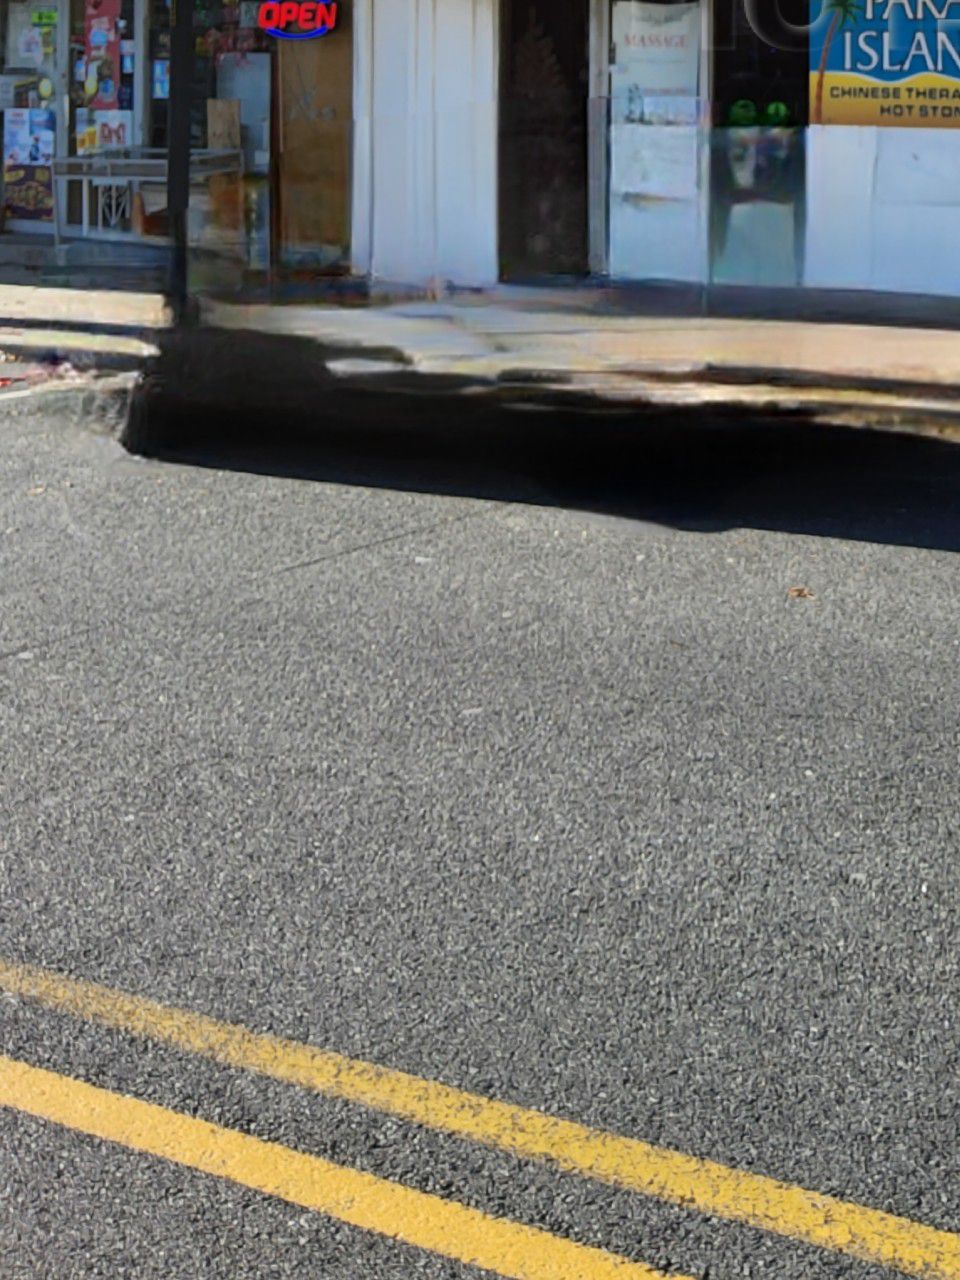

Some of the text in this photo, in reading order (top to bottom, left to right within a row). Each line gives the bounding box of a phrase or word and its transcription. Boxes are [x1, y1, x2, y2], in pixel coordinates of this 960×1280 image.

[257, 0, 338, 30] OPEN
[829, 86, 901, 99] CHINESE
[879, 104, 917, 117] HOT
